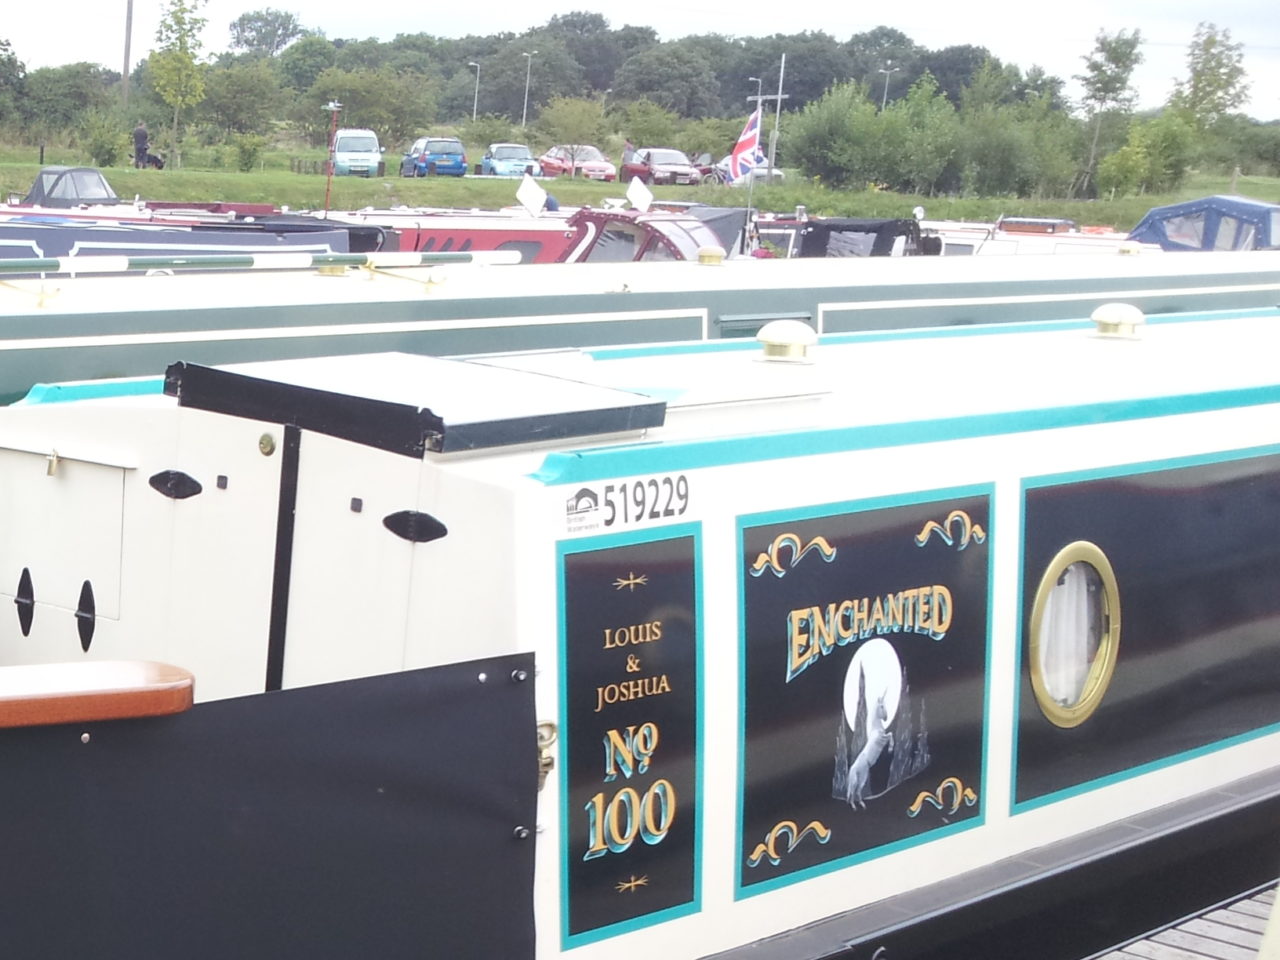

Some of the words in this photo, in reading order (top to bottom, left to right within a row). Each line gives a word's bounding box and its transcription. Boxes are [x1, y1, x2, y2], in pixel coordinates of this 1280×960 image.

[603, 474, 689, 526] 519229
[603, 621, 662, 649] LOUIS
[786, 584, 953, 683] ENCHANTED
[626, 653, 640, 672] &
[594, 674, 672, 712] JOSHUA
[583, 779, 676, 861] 100
